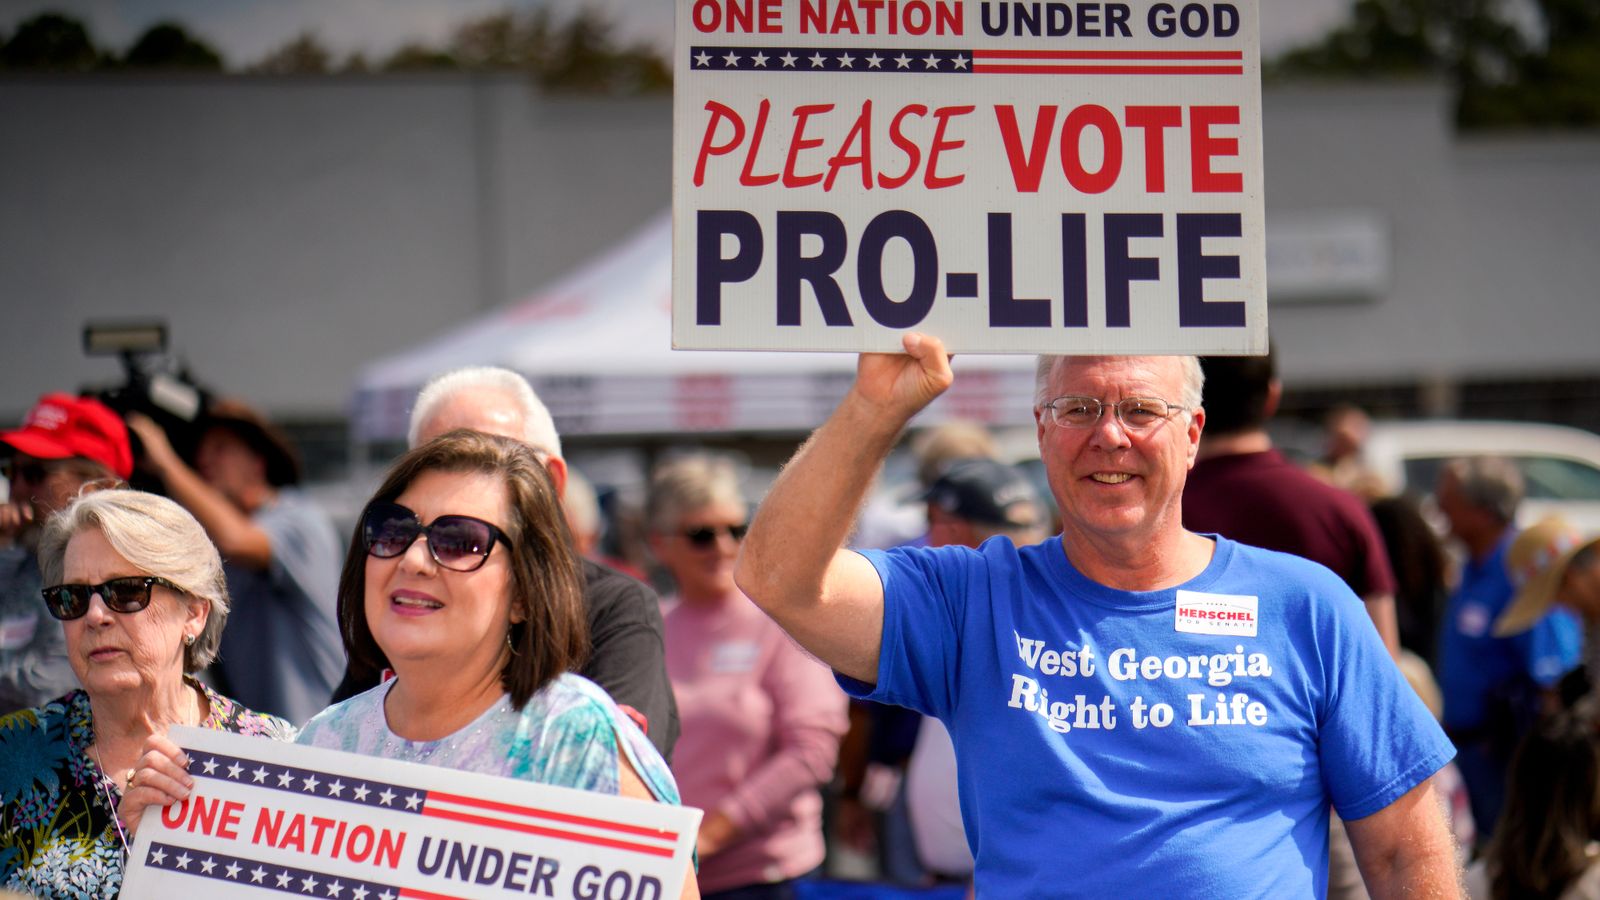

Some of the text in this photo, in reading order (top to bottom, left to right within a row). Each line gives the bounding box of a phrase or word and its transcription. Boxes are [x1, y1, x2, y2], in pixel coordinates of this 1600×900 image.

[692, 0, 1240, 38] ONE NATION UNDER GOD
[693, 98, 1243, 194] PLEASE VOTE
[696, 209, 1246, 329] PRO-LIFE
[1178, 608, 1254, 622] HERSCHEL
[1013, 629, 1272, 687] West Georgia
[1008, 674, 1268, 733] Right to Life
[161, 795, 662, 900] ONE NATION UNDER GOD
